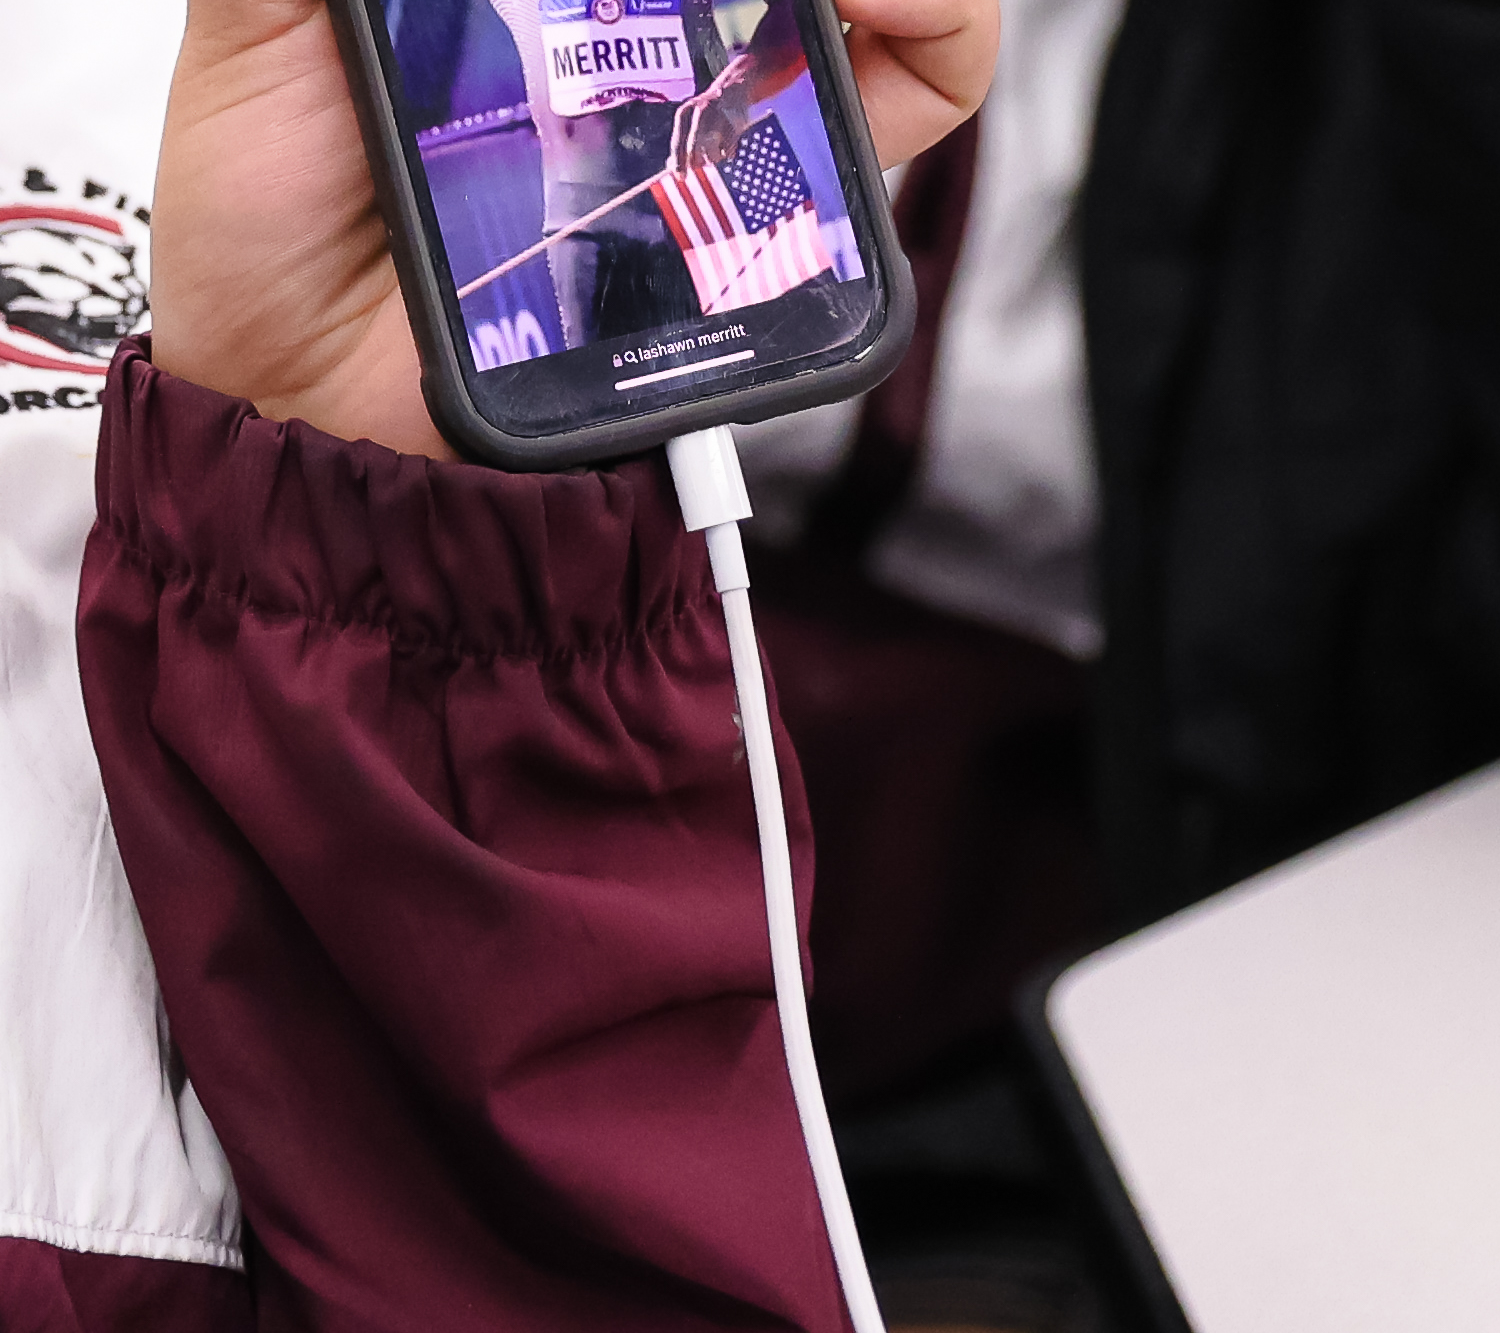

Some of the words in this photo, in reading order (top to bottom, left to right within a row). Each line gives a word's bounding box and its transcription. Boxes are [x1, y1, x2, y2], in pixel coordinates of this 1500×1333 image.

[553, 37, 681, 79] MERRITT
[638, 339, 696, 362] lashawn
[698, 323, 747, 347] merritt
